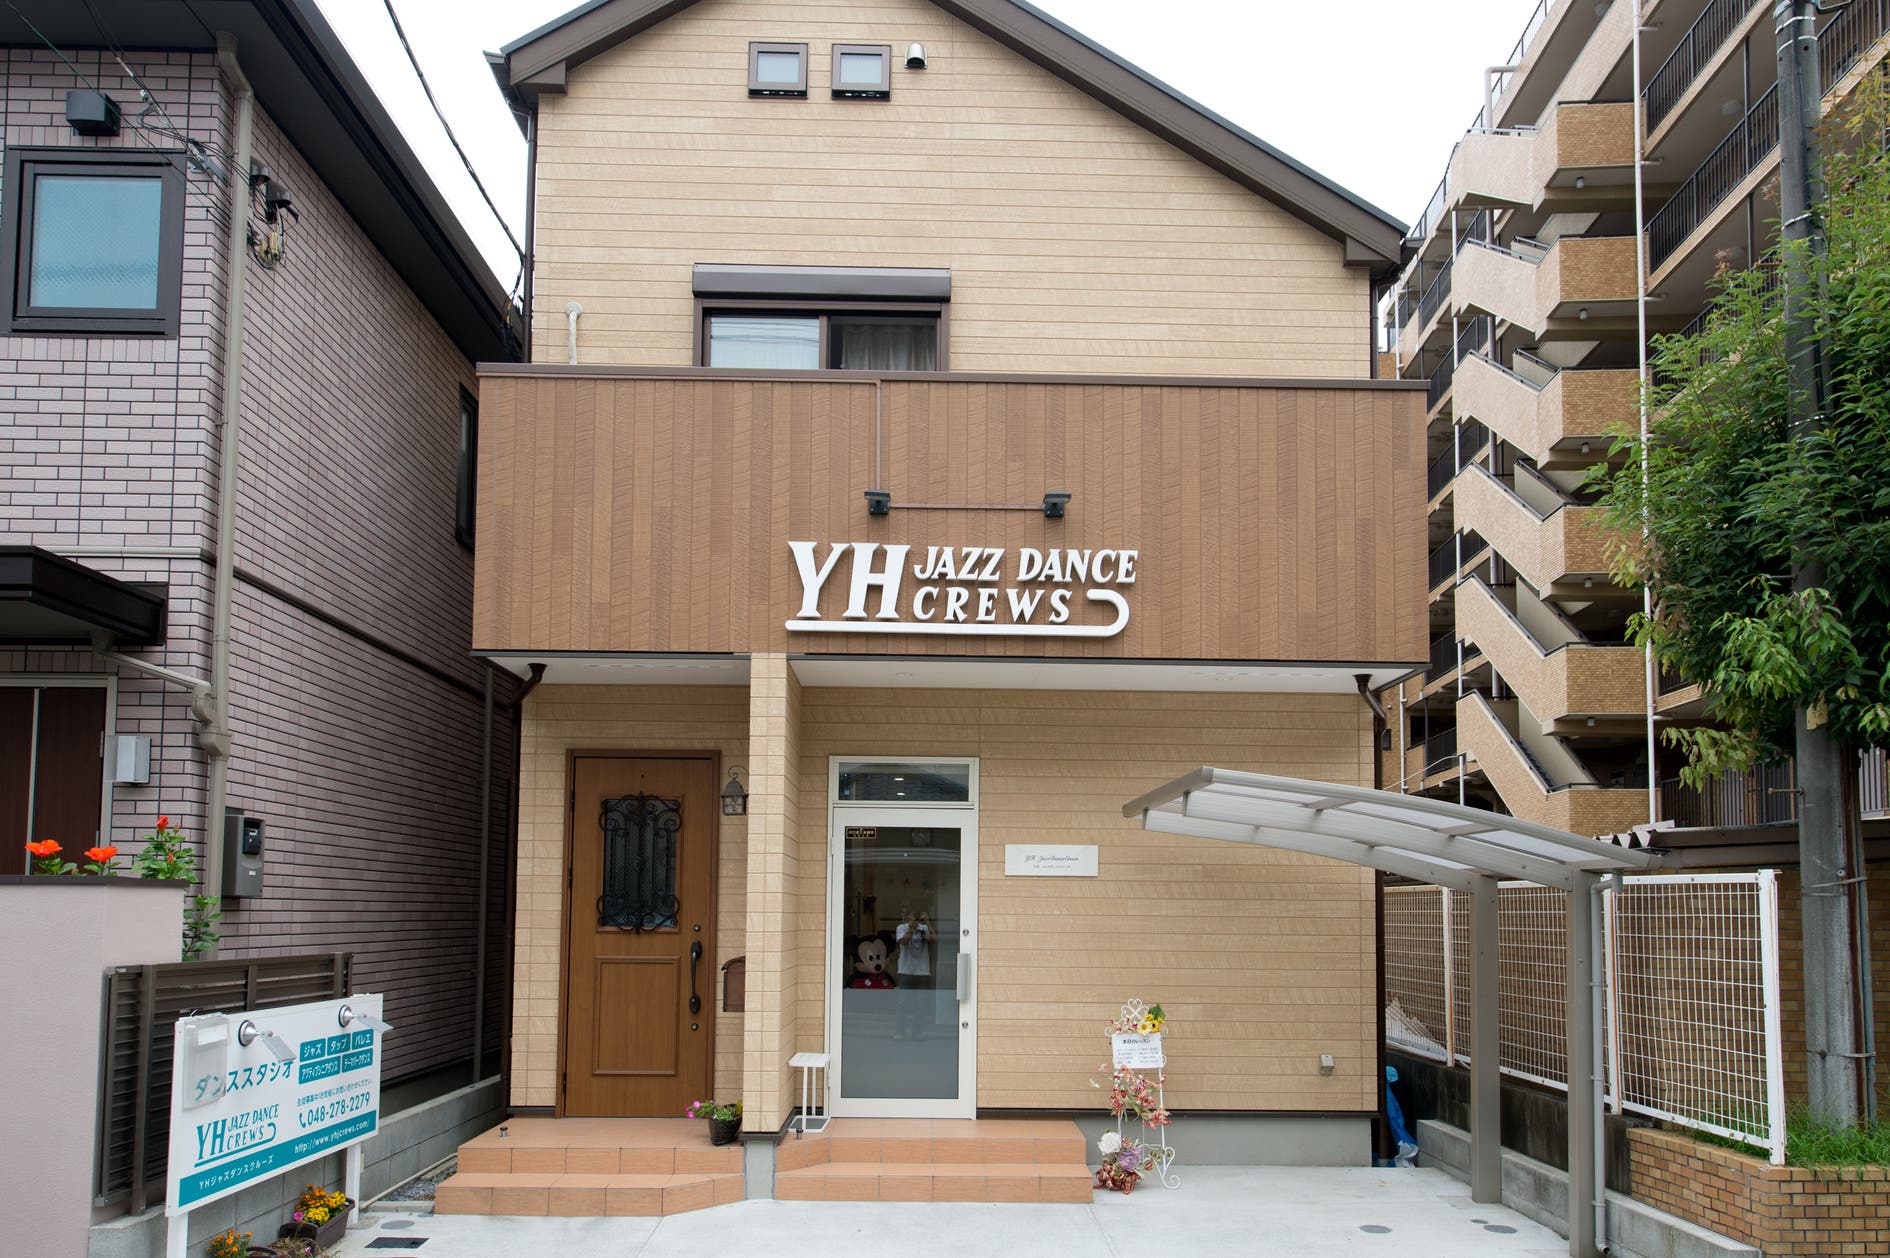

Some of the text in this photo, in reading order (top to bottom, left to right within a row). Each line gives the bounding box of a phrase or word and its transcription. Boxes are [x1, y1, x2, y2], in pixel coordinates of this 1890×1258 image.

[788, 541, 911, 618] YH
[913, 546, 1138, 584] JAZZ DANCE
[912, 586, 1073, 623] CREWS
[303, 1043, 323, 1058] ジャズ
[330, 1037, 348, 1052] タップ
[354, 1033, 371, 1046] バレエ
[195, 1060, 294, 1101] ダンススタジオ
[228, 1103, 279, 1132] JAZZ DANCE
[307, 1091, 371, 1125] 048-278-2279
[196, 1118, 228, 1161] YH
[227, 1125, 265, 1151] CREWS
